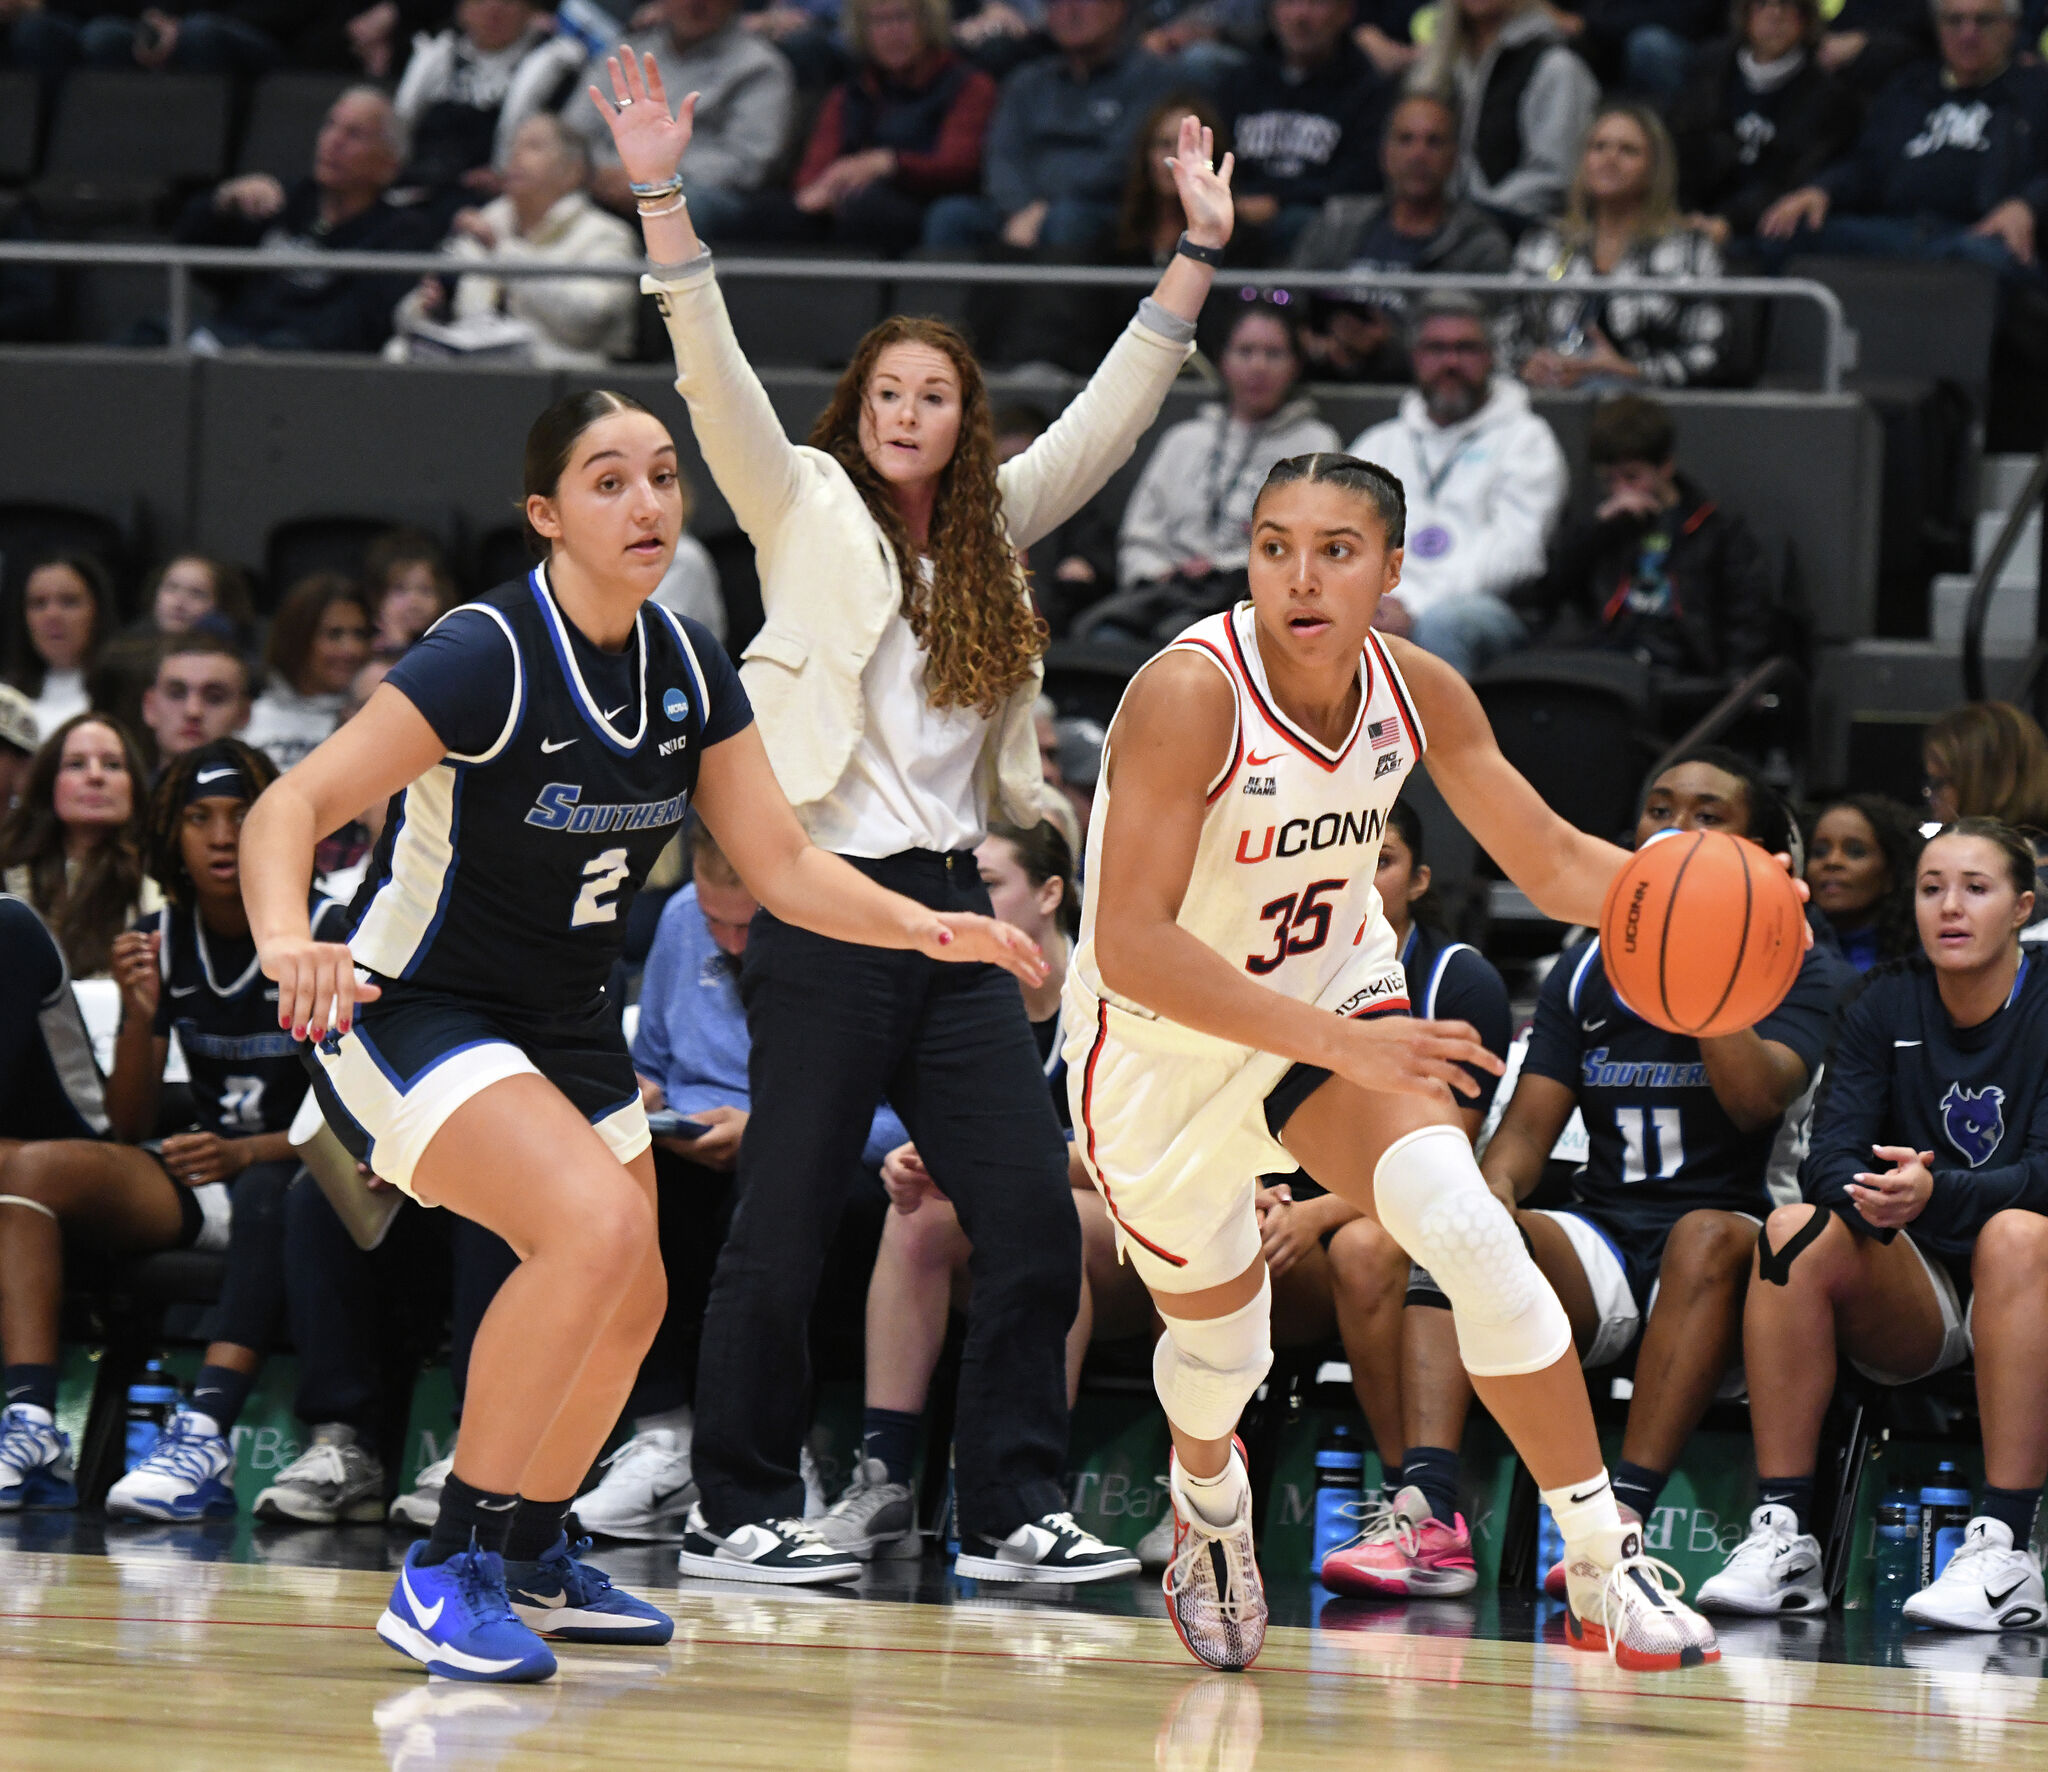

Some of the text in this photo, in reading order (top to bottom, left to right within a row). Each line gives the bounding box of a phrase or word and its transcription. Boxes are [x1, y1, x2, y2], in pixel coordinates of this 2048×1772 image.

[1242, 785, 1277, 796] CHANG
[1264, 776, 1276, 786] TH
[1235, 807, 1389, 865] UCONN
[570, 847, 631, 929] 2
[1625, 881, 1650, 955] UCONN
[1245, 878, 1350, 976] 35
[1614, 1105, 1684, 1184] 11
[1921, 1507, 1933, 1591] OWERADE
